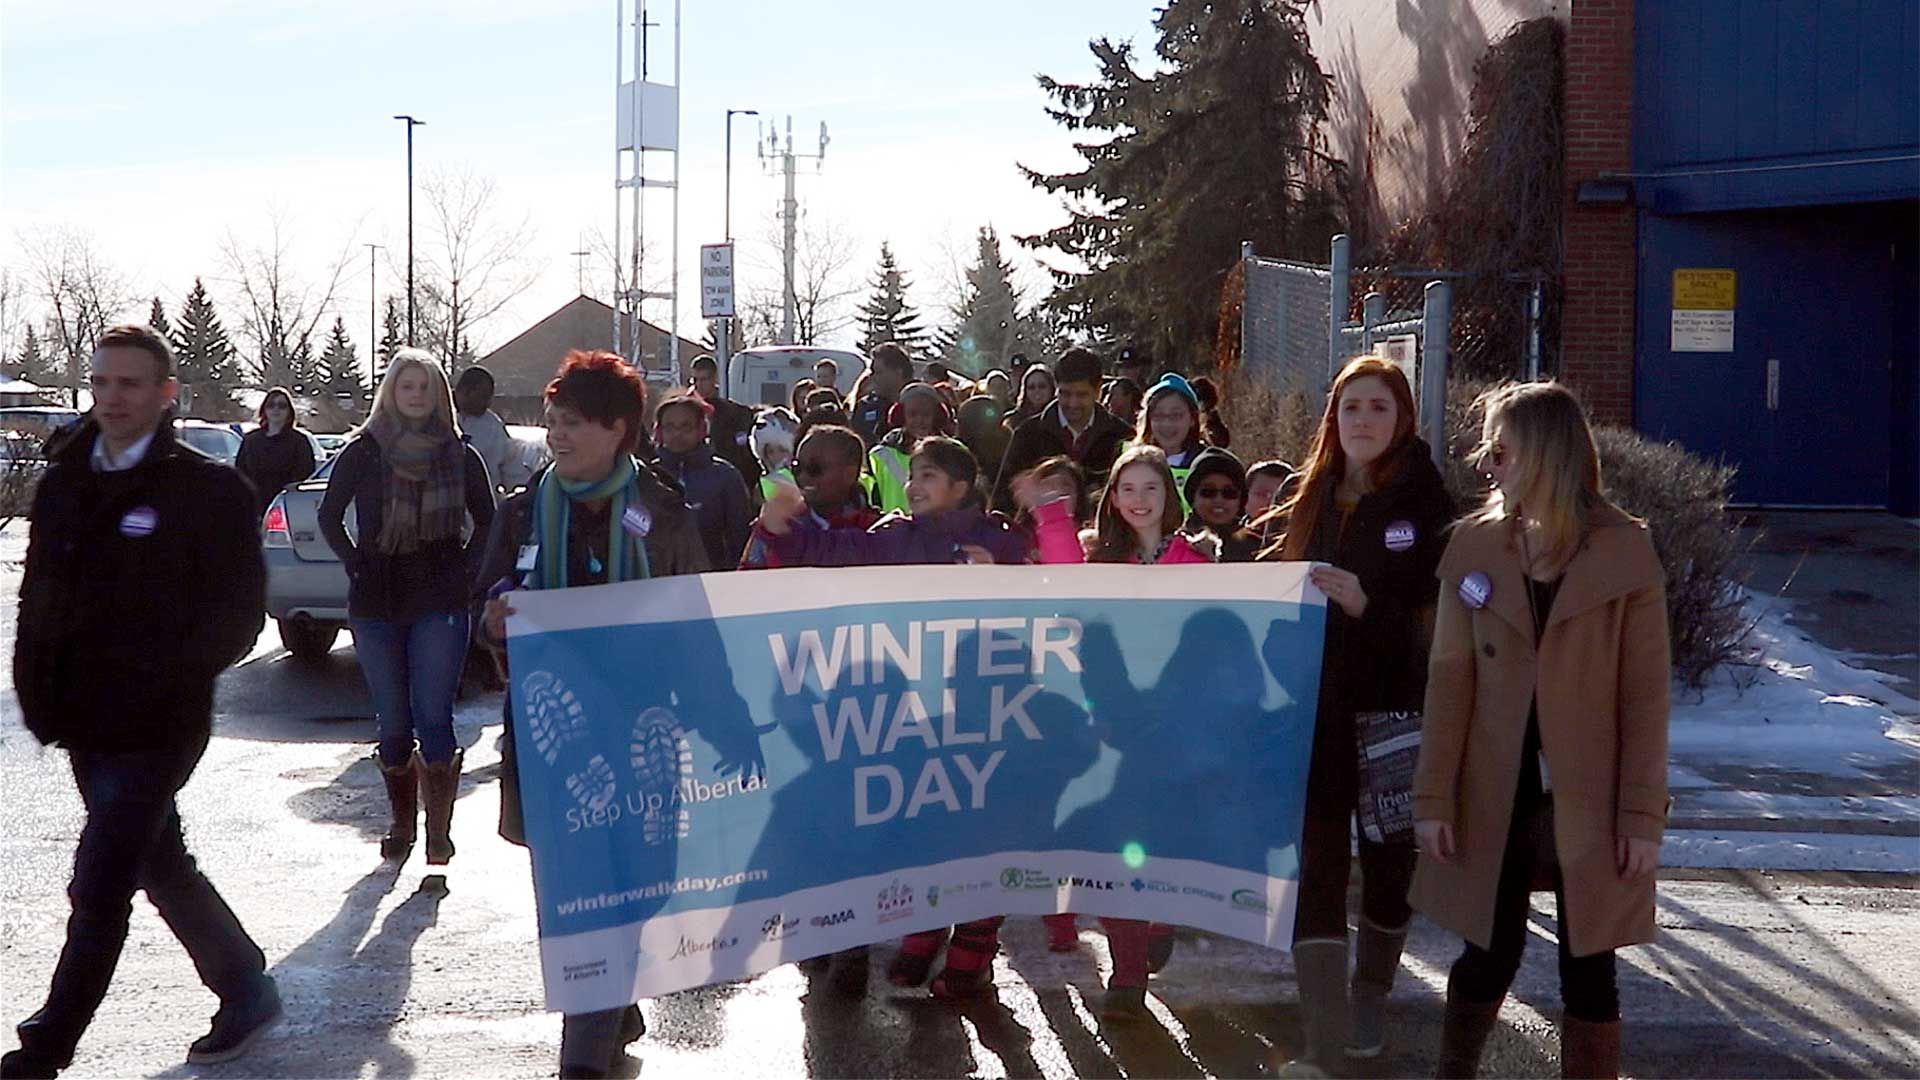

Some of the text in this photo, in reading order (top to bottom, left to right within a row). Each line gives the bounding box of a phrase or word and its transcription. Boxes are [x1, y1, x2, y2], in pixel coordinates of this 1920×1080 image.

[711, 251, 721, 262] NO
[704, 266, 730, 277] PARKING
[711, 298, 725, 307] ZONE
[768, 616, 1085, 696] WINTER
[812, 684, 1046, 763] WALK
[854, 750, 1008, 827] DAY
[566, 801, 622, 833] Step
[626, 790, 662, 815] Up
[557, 870, 768, 915] winterwalkday.com
[1182, 885, 1225, 902] CROSS
[821, 909, 856, 927] AMA
[669, 935, 729, 961] Alberta
